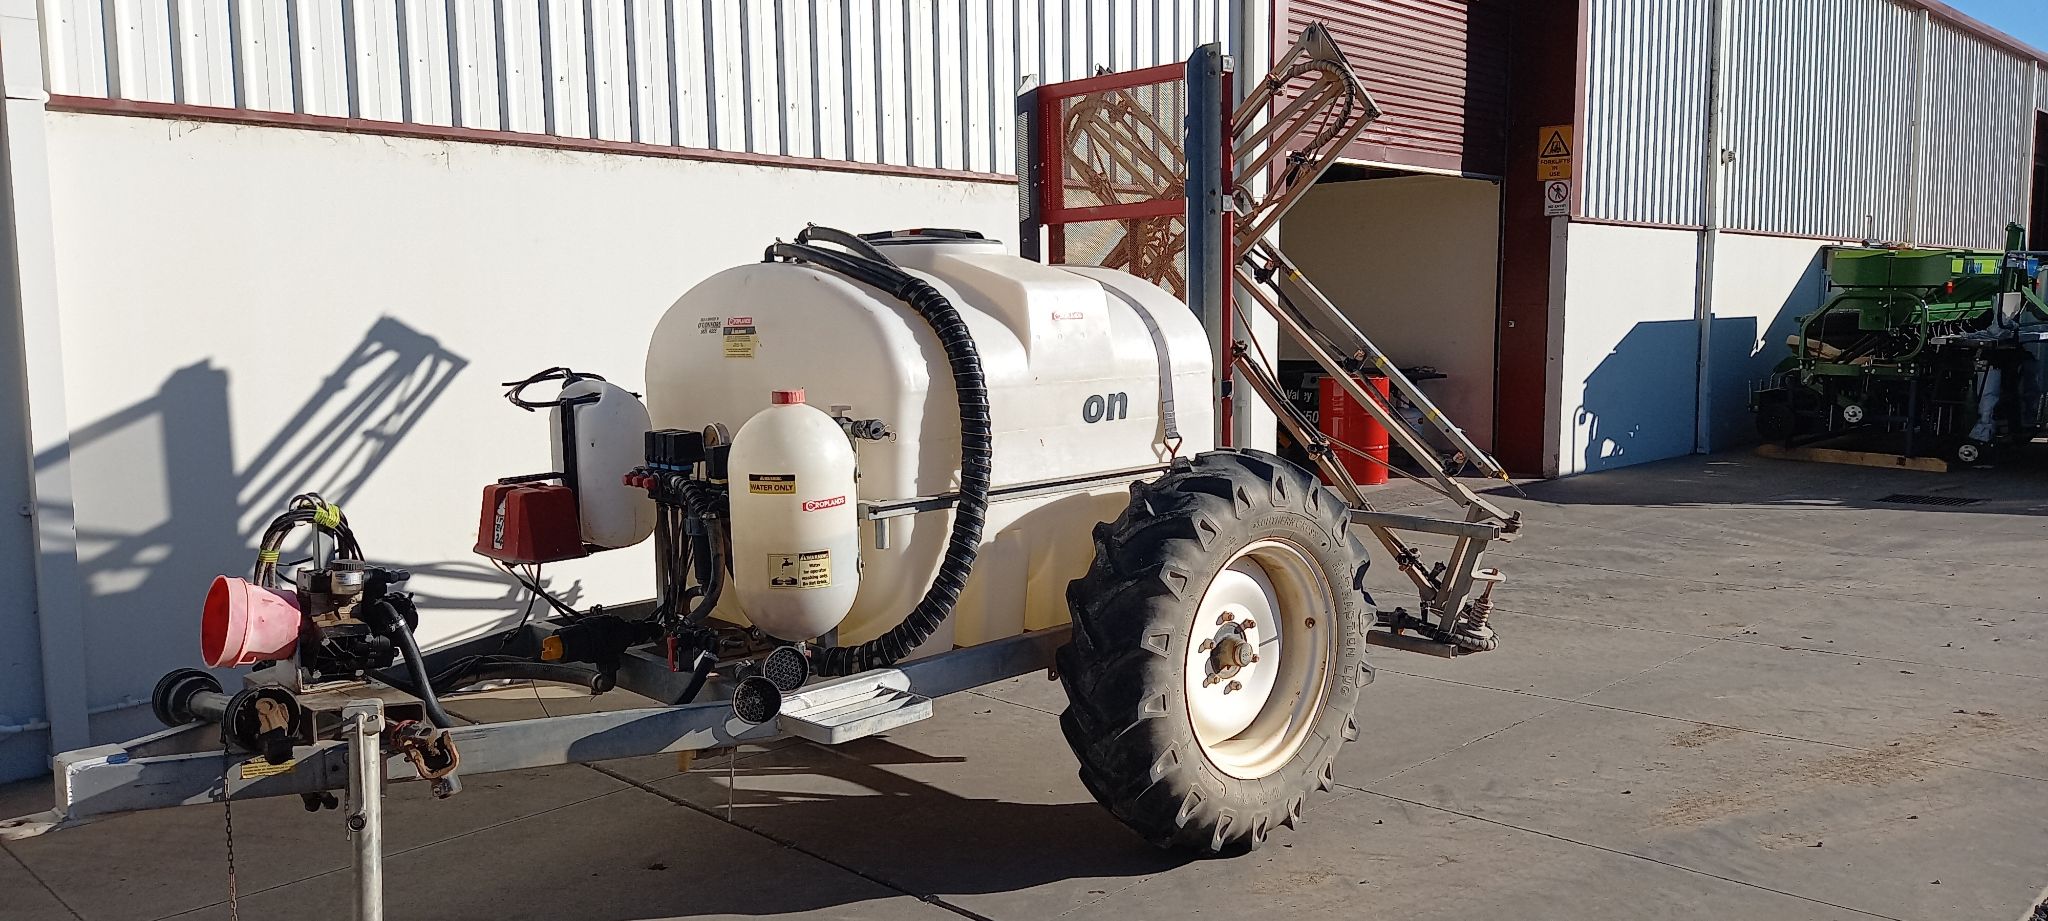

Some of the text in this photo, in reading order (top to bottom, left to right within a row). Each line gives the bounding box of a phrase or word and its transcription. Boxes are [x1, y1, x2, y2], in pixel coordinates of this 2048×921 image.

[1082, 392, 1128, 424] on
[1286, 389, 1313, 403] Valey
[805, 496, 845, 512] CROPLANDS
[1340, 664, 1354, 697] LUG
